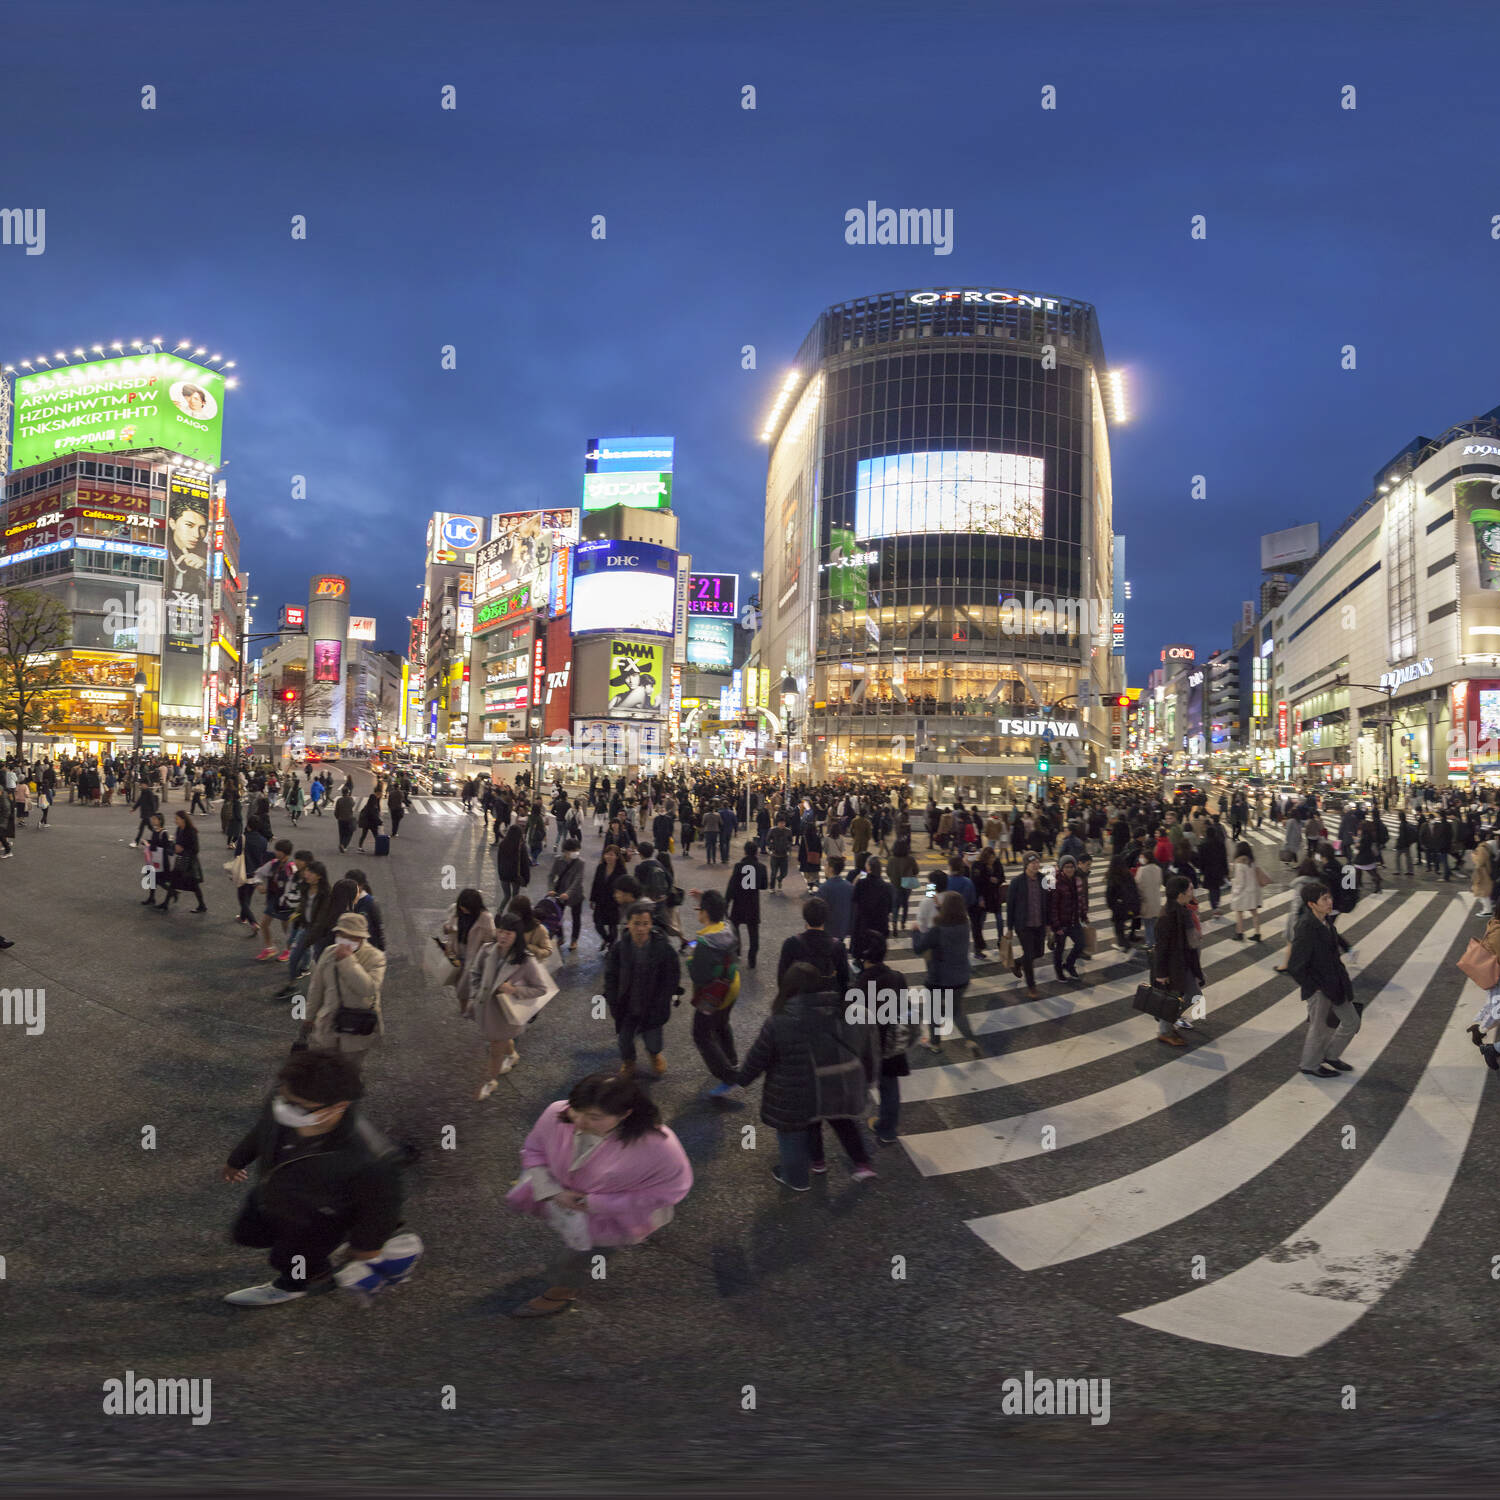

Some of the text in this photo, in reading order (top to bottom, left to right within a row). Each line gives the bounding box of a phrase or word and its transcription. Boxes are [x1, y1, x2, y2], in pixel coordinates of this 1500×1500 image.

[910, 291, 1059, 310] QFRONT
[176, 415, 209, 432] DAIGO
[78, 490, 148, 509] コンタクト
[36, 512, 65, 528] ガスト
[126, 514, 160, 528] ガスト
[446, 523, 477, 541] UC
[607, 556, 639, 566] DHC
[315, 580, 345, 597] 109
[722, 602, 734, 613] 21
[1112, 612, 1125, 648] SEIBU
[613, 642, 654, 659] DMM
[611, 656, 641, 673] FX
[998, 719, 1079, 738] TSUTAYA
